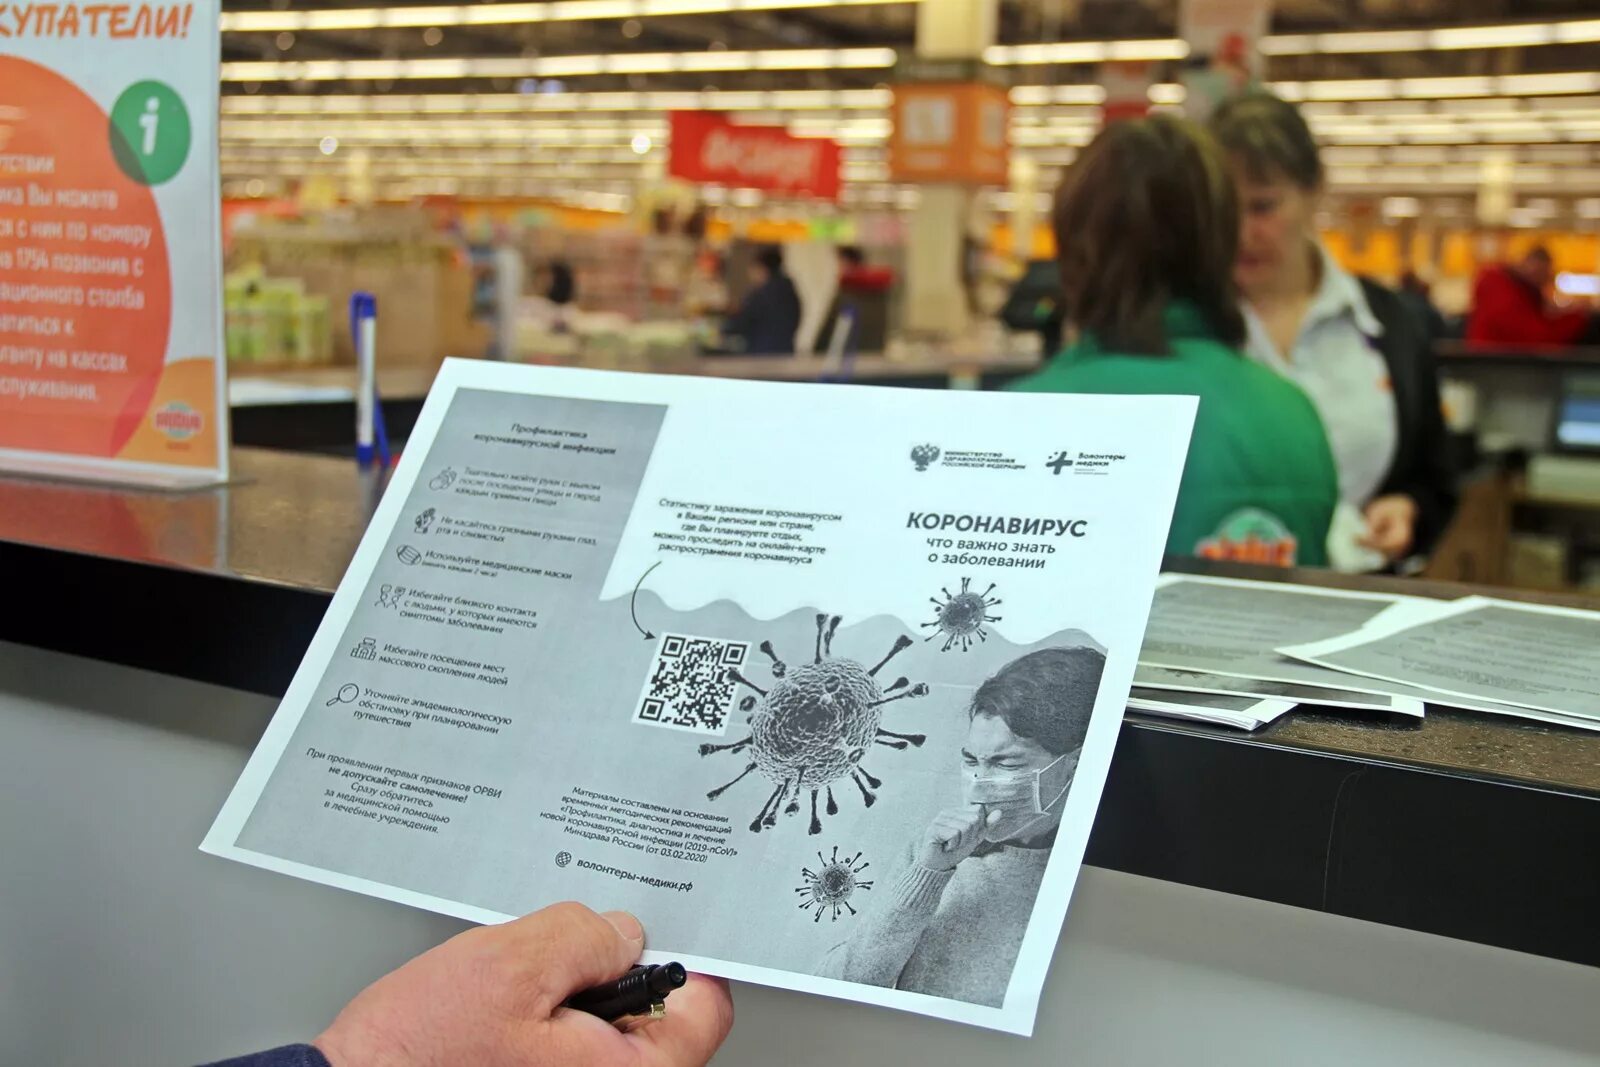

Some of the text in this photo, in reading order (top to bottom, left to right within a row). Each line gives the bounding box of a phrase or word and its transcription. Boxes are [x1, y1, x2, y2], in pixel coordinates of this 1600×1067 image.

[92, 225, 152, 249] номеру
[473, 432, 616, 455] коронавирусной инфекции
[511, 423, 588, 439] Профилактика
[1075, 459, 1110, 468] медики
[1078, 452, 1126, 461] Волонтеры
[658, 498, 842, 522] Статистику заражения коронавирусом
[684, 512, 716, 522] Вашем
[717, 516, 757, 527] регионе
[778, 521, 815, 532] стране,
[436, 526, 451, 535] рта
[460, 530, 505, 543] слизистых
[441, 516, 452, 525] Не
[454, 517, 497, 531] касайтесь
[498, 525, 542, 539] грязными
[542, 531, 576, 543] руками
[681, 524, 803, 542] где Вы планируете отдых,
[906, 511, 1088, 538] КОРОНАВИРУС
[653, 532, 686, 541] можно
[687, 535, 744, 548] проследить
[759, 541, 826, 556] онлайн-карте
[658, 543, 813, 565] распространения коронавируса
[926, 537, 1056, 554] что важно знать
[425, 550, 573, 580] Используйте медицинские маски
[928, 553, 1046, 569] о заболевании
[409, 588, 537, 618] Избегайте близкого контакта
[411, 602, 448, 615] людьми,
[449, 607, 455, 616] у
[456, 609, 495, 623] которых
[496, 615, 538, 630] имеются
[399, 609, 504, 634] симптомы заболевания
[379, 655, 508, 687] массового скопления людей
[383, 643, 505, 674] Избегайте посещения мест
[354, 710, 412, 729] путешествия
[358, 700, 500, 735] обстановку при планировании
[363, 687, 512, 726] Уточняйте эпидемиологическую
[306, 747, 503, 799] При проявлении первых признаков ОРВИ
[328, 766, 469, 804] не допускайте самолечение!
[324, 789, 450, 824] за медицинской помощью
[350, 781, 434, 808] Сразу обратитесь
[572, 786, 619, 803] Материалы
[620, 797, 671, 814] составлены
[683, 809, 729, 823] основании
[331, 802, 378, 820] лечебные
[379, 814, 440, 834] учреждения.
[560, 806, 627, 826] «Профилактика,
[628, 821, 684, 838] диагностика
[692, 832, 726, 845] лечение
[561, 794, 732, 834] временных методических рекомендаций
[539, 812, 738, 857] новой коронавирусной инфекции (2019-nCoV)»
[563, 825, 708, 863] Минздрава России (от 03.02.2020)
[576, 859, 694, 892] волонтеры-медики.рф
